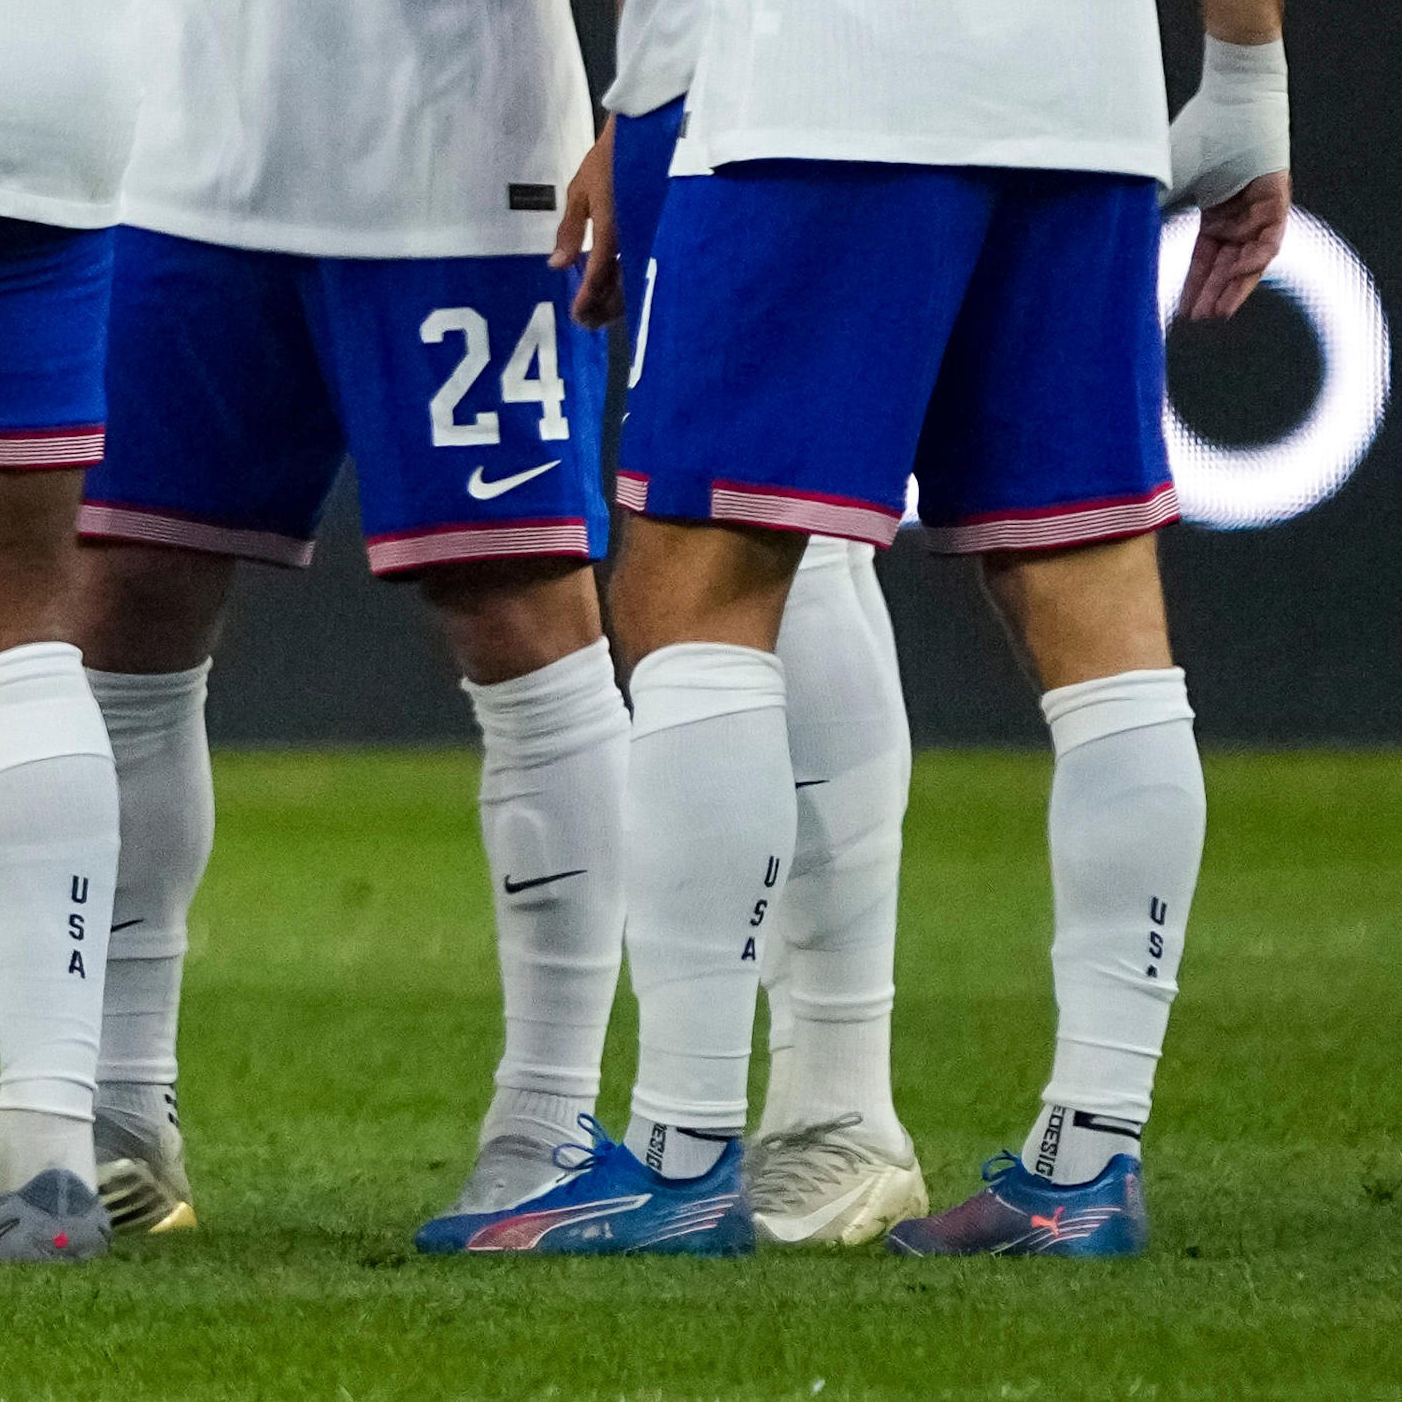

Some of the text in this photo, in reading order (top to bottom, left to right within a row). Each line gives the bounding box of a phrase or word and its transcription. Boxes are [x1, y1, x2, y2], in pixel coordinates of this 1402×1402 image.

[420, 302, 570, 447] 24
[68, 875, 89, 980] USA
[740, 855, 781, 962] USA
